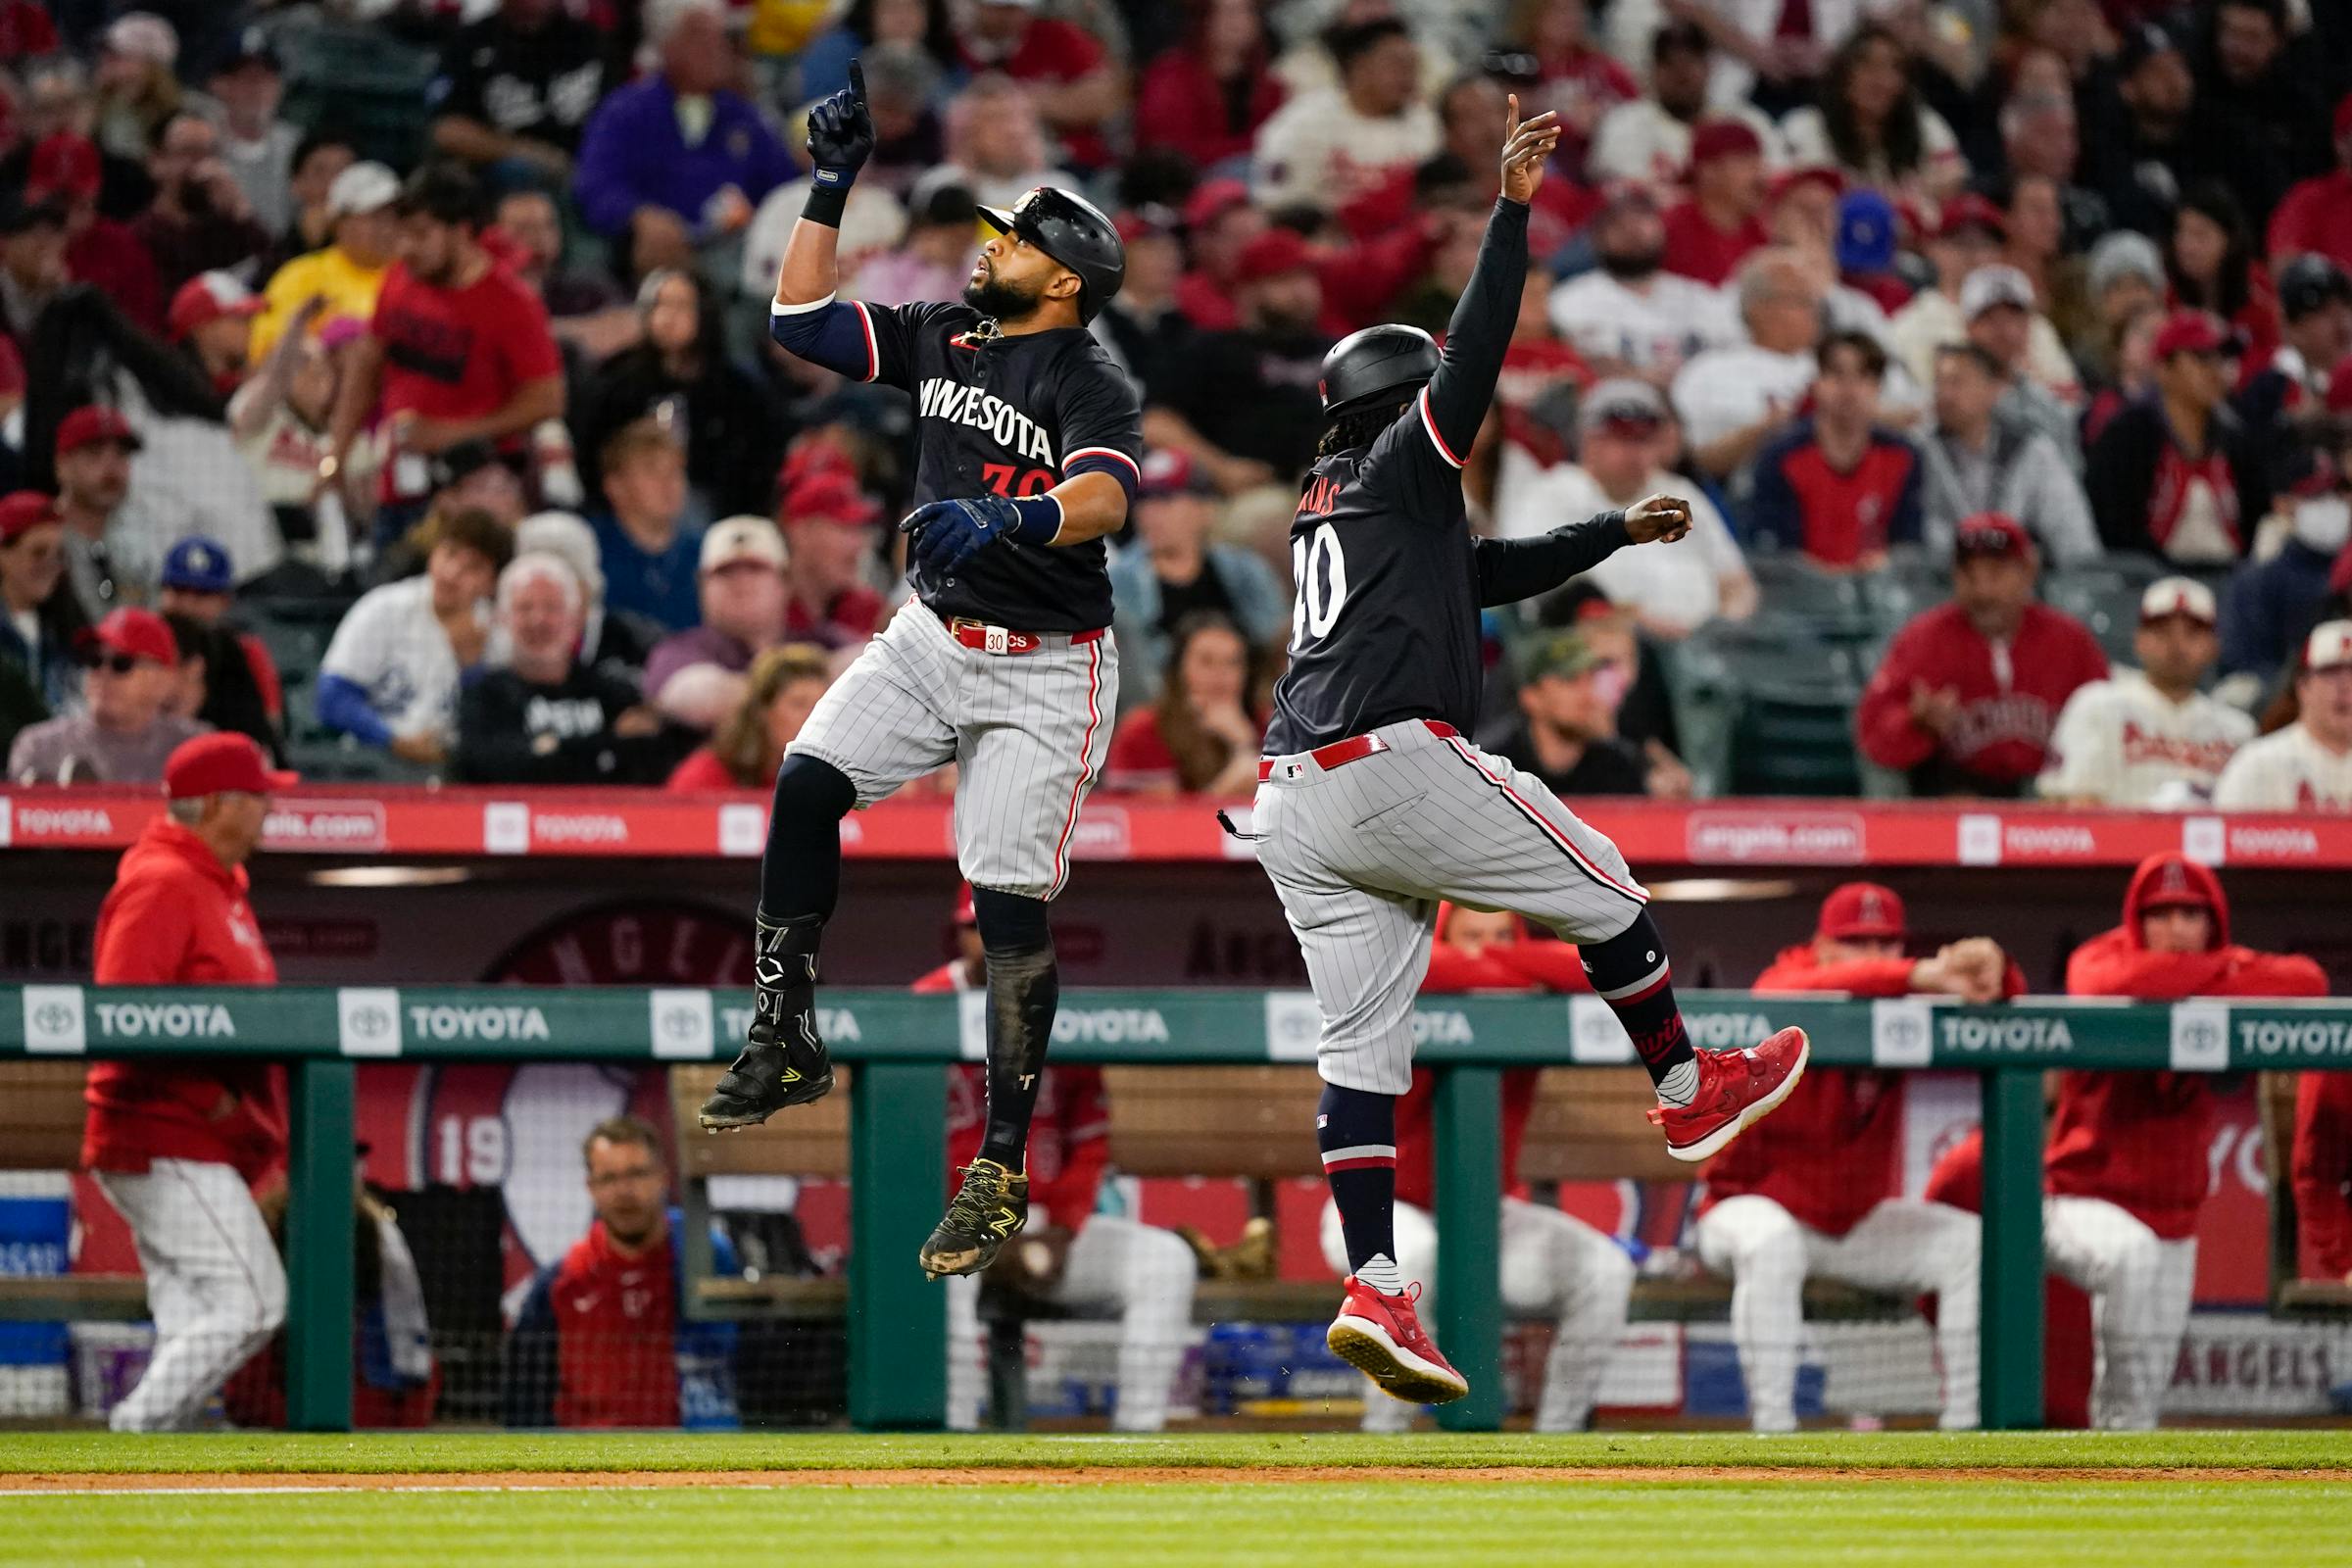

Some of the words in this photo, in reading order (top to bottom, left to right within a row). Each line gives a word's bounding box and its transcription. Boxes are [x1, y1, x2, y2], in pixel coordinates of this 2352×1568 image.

[988, 633, 1004, 651] 30
[1007, 634, 1028, 648] CS
[19, 809, 113, 835] TOYOTA
[533, 815, 628, 842] TOYOTA
[1695, 823, 1853, 859] angels.com
[2005, 827, 2096, 853] TOYOTA
[2230, 829, 2318, 855] TOYOTA
[95, 1003, 236, 1037] TOYOTA
[410, 1005, 550, 1041] TOYOTA
[1051, 1008, 1169, 1044] OYOTA
[1941, 1016, 2074, 1052] TOYOTA
